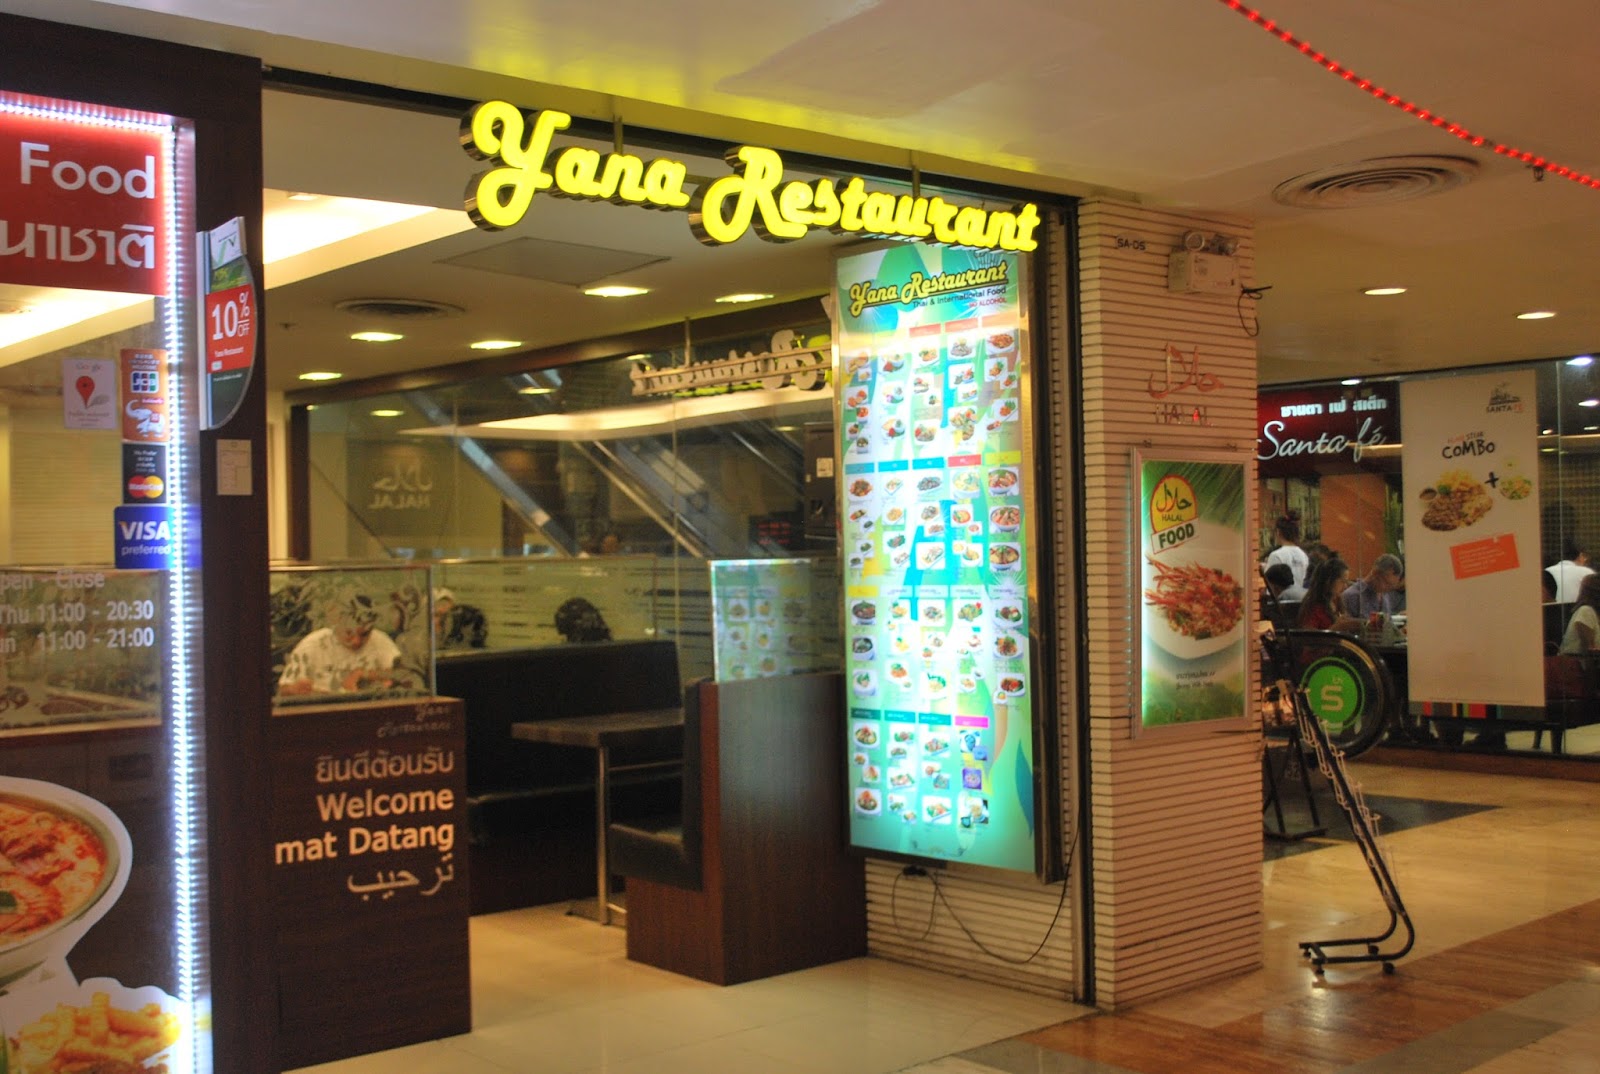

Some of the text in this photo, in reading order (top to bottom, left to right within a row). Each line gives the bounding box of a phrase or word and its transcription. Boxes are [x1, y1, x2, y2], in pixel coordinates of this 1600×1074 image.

[20, 141, 156, 200] Food
[471, 100, 1041, 252] Yana Restaurant
[849, 260, 1008, 318] Yana Restaurant
[987, 285, 1007, 295] Food
[1257, 420, 1350, 461] Santa
[1442, 439, 1496, 459] COMBO
[1155, 482, 1193, 513] حلال
[1161, 513, 1183, 522] HALAL
[119, 520, 172, 541] VISA
[1158, 523, 1195, 549] FOOD
[121, 543, 172, 557] preferred
[55, 568, 106, 589] Close
[36, 602, 86, 624] 11:00
[106, 599, 155, 621] 20:30
[36, 630, 86, 651] 11:00
[106, 626, 155, 649] 21:00
[316, 788, 455, 823] Welcome
[275, 823, 455, 865] mat Datang
